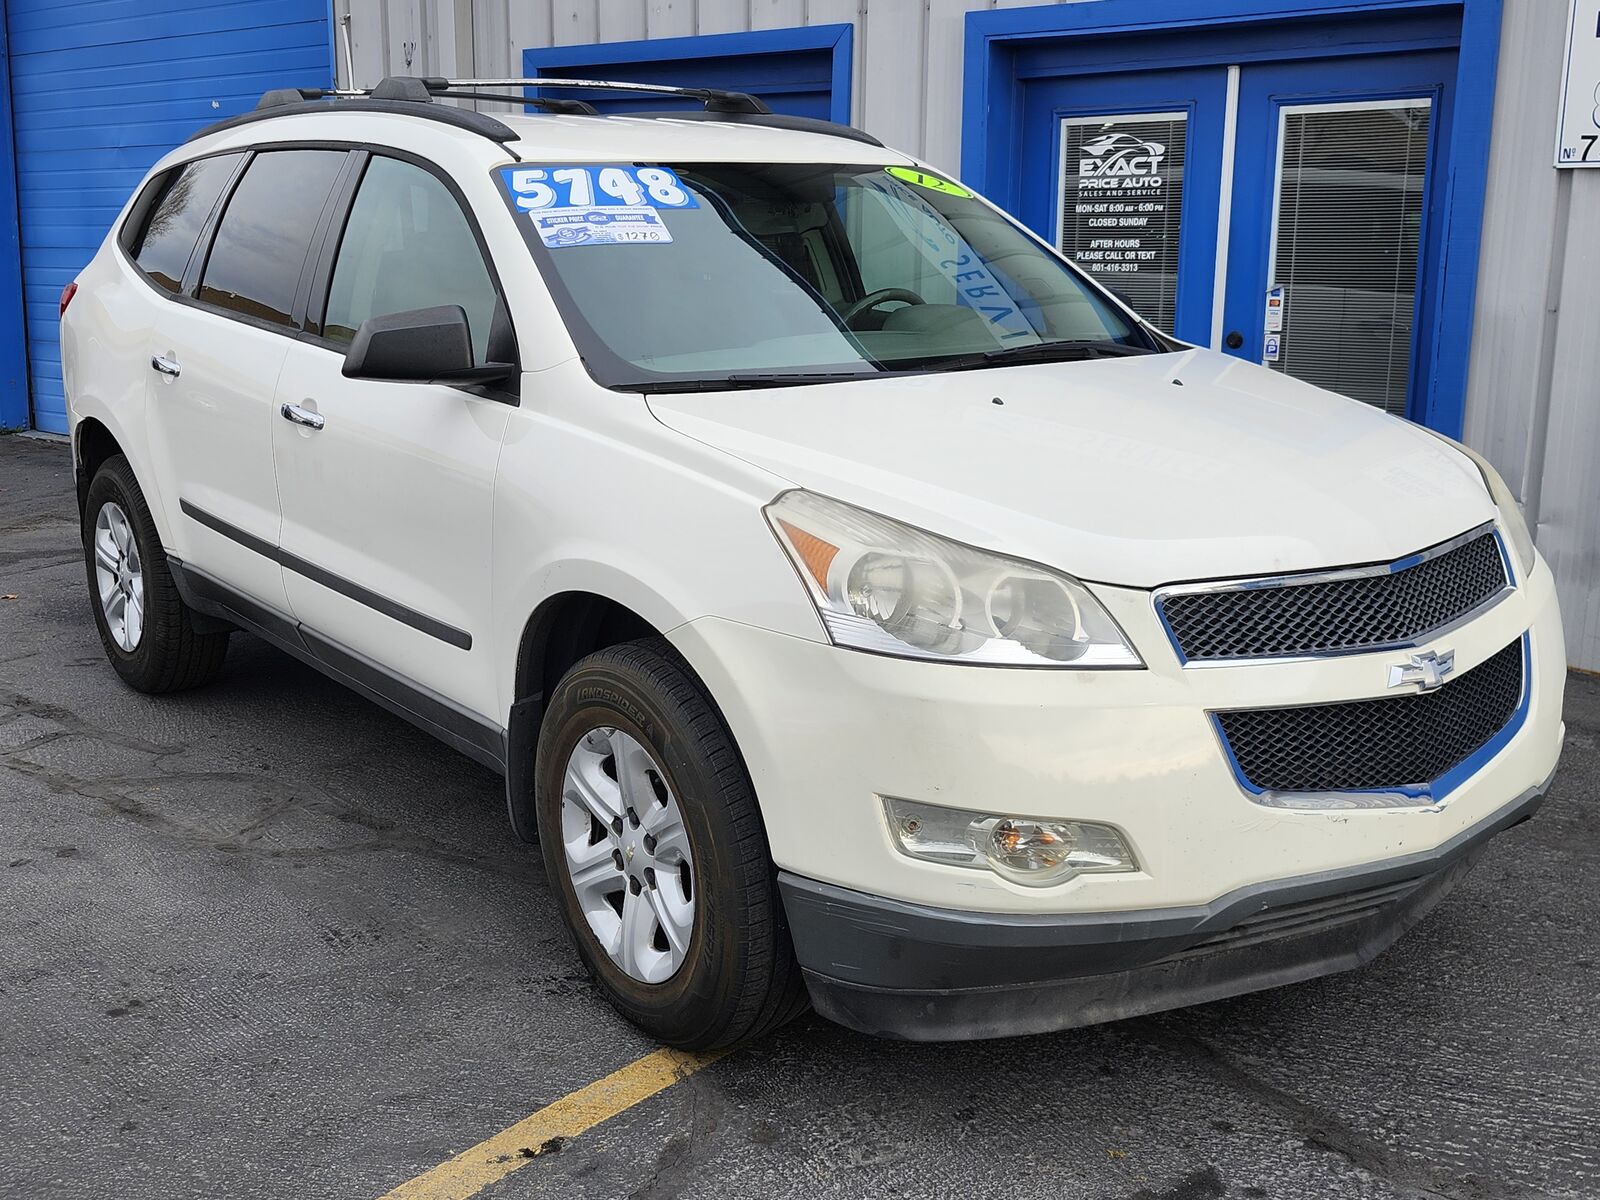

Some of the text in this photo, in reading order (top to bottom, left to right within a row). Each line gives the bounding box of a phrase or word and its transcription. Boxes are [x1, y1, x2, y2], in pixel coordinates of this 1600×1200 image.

[1079, 155, 1164, 177] EXACT
[917, 174, 947, 191] 12
[1079, 176, 1162, 189] PRICE AUTO
[512, 168, 689, 207] 5748
[1126, 188, 1161, 196] SERVICE
[1075, 204, 1108, 213] MON-SAT
[1109, 204, 1124, 212] 8:00
[1138, 203, 1154, 212] 6:00
[547, 216, 568, 224] STICKER
[569, 215, 585, 223] PRICE
[1088, 217, 1148, 226] CLOSED SUNDAY
[1090, 239, 1140, 248] AFTER HOURS
[1076, 251, 1156, 260] PLEASE CALL OR TEXT
[1092, 263, 1138, 272] 801-416-3313
[576, 687, 646, 727] LANDSPIDER
